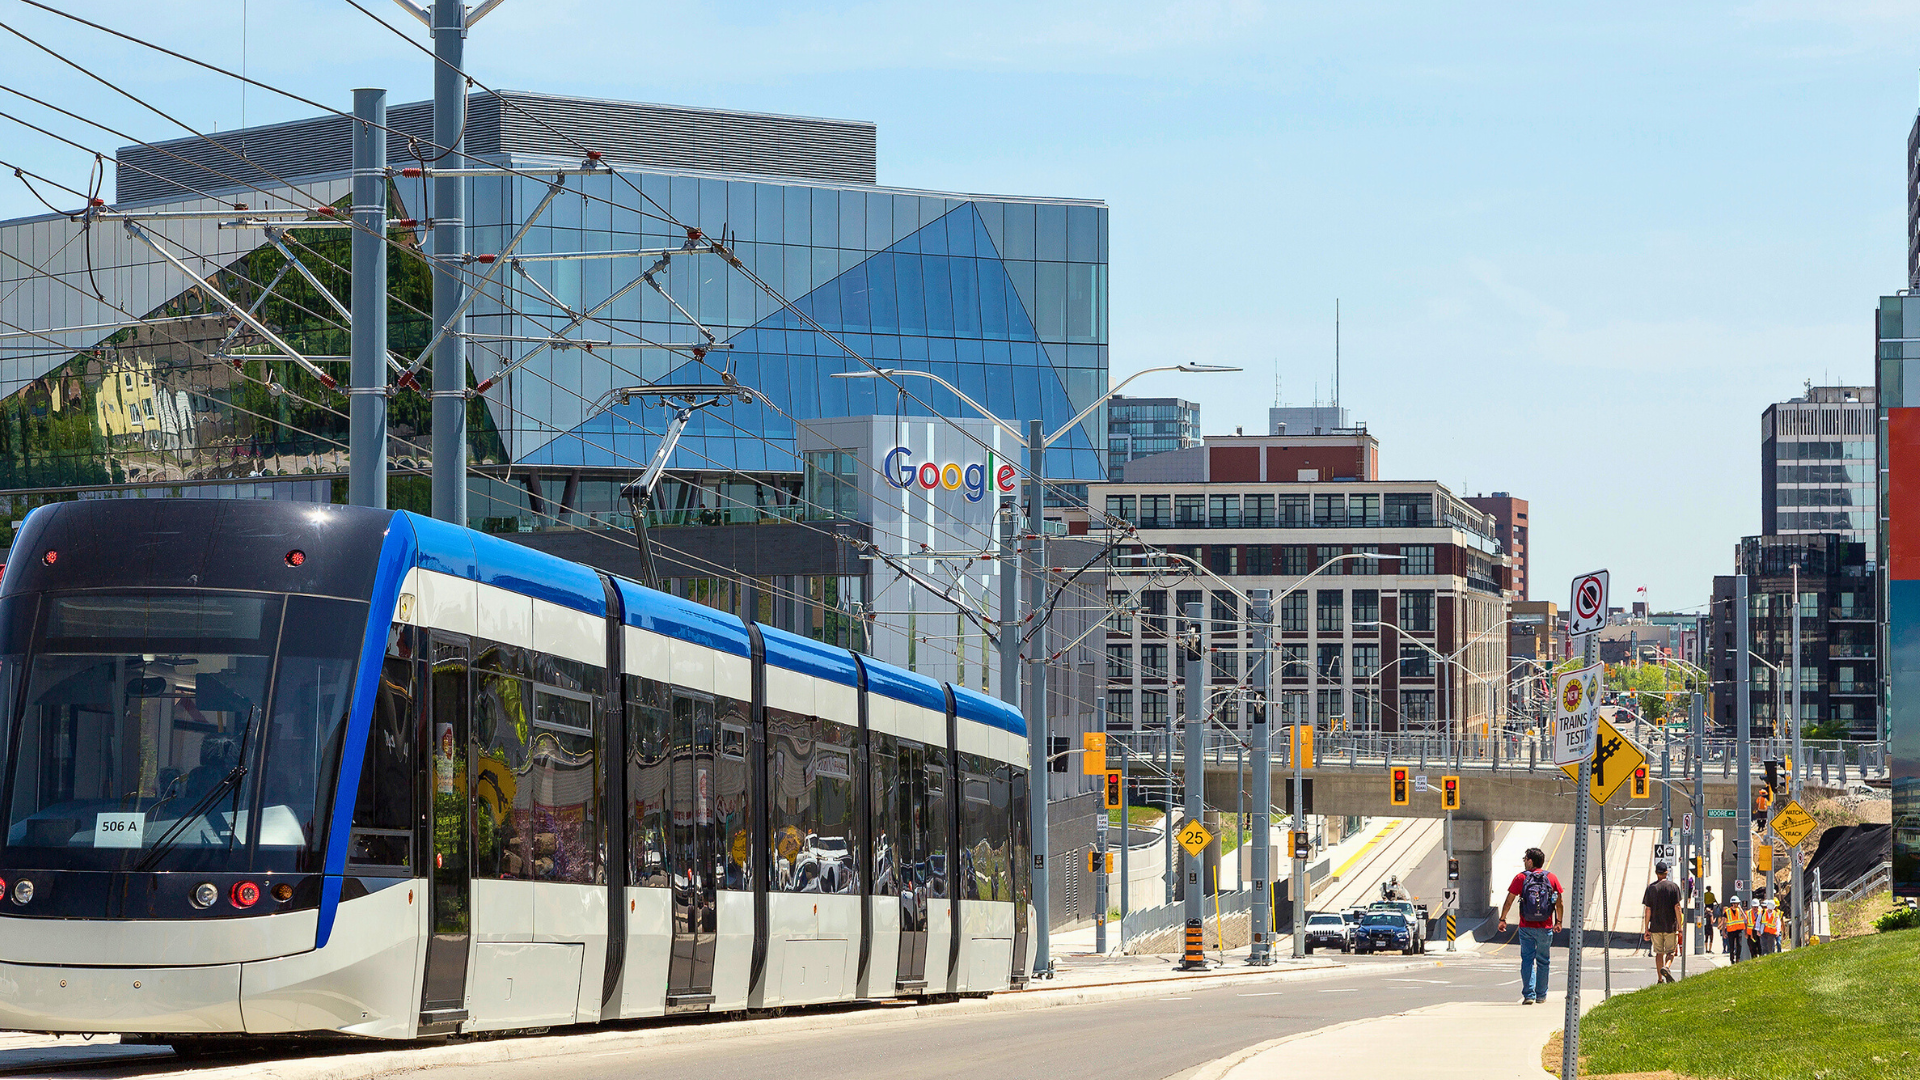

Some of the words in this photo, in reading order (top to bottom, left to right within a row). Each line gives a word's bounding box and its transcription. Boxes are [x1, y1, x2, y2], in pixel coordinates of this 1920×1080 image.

[883, 446, 1016, 503] Google
[1567, 689, 1580, 702] NEW
[1559, 712, 1588, 731] TRAINS
[102, 821, 125, 832] 506
[127, 821, 137, 831] A
[1185, 831, 1204, 845] 25
